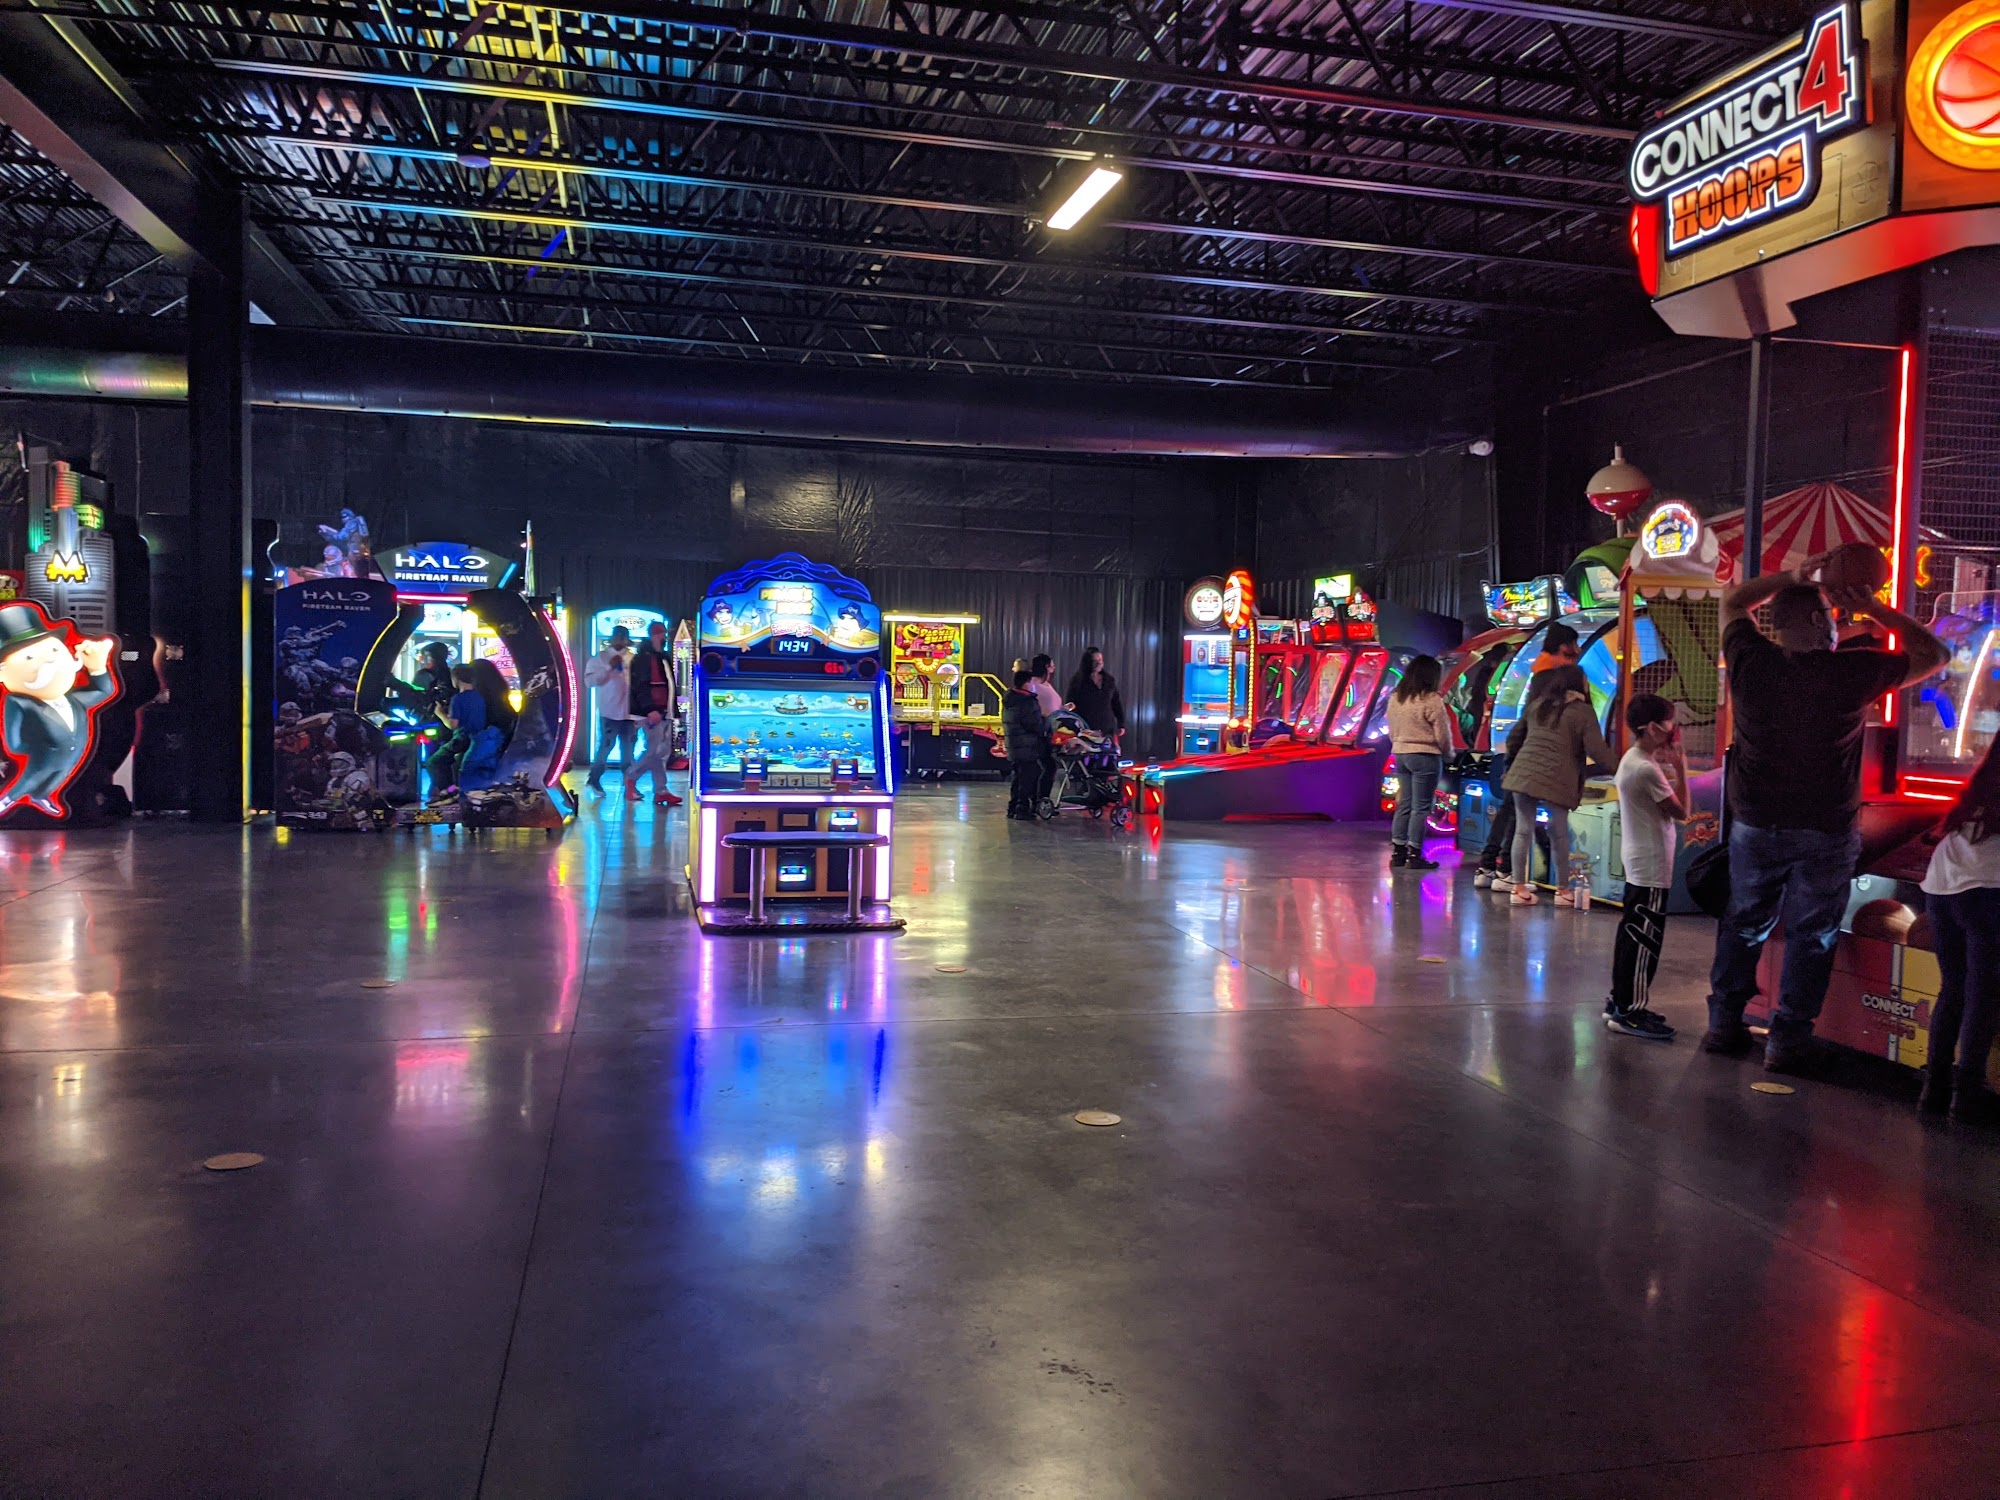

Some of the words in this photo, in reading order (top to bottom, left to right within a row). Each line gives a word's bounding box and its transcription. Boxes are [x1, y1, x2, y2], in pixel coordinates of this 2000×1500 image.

[1635, 66, 1802, 189] CONNECT
[1797, 18, 1849, 119] 4
[1671, 140, 1806, 244] HOOPS
[394, 553, 489, 570] HALO
[394, 572, 449, 582] FIRETEAM
[451, 574, 488, 583] RAVEN
[302, 589, 371, 602] HALO
[778, 640, 810, 653] 1434
[1861, 993, 1916, 1019] CONNECT
